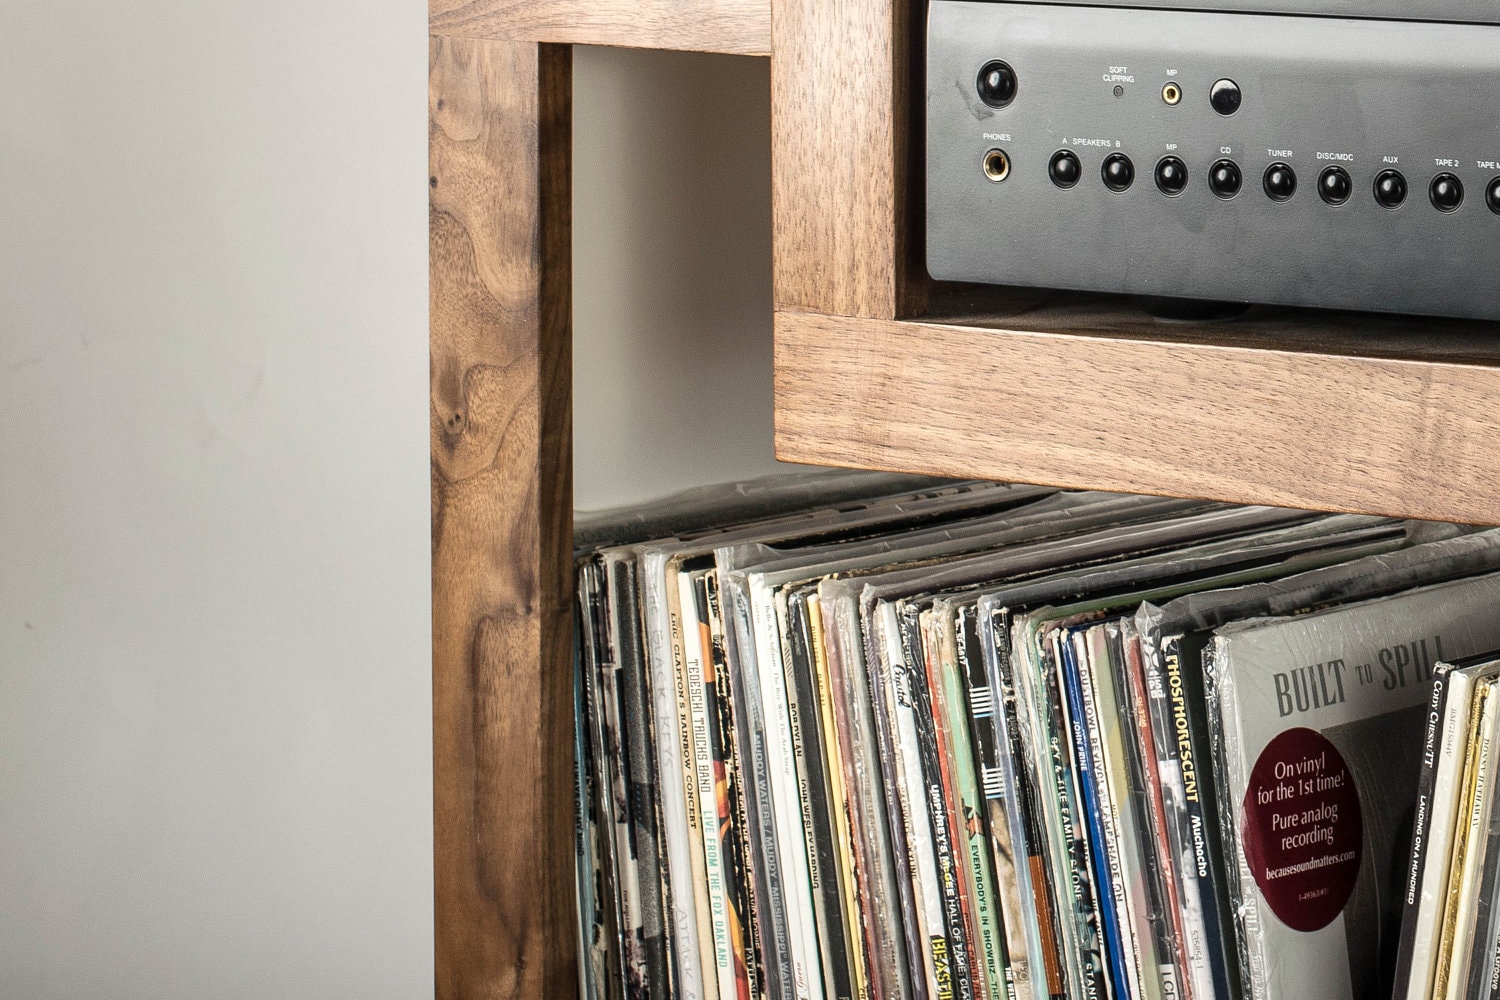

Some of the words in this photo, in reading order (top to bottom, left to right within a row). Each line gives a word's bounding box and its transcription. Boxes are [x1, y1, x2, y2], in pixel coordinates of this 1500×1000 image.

[1103, 74, 1135, 84] CLIPPING
[1109, 66, 1128, 74] SOFT
[1166, 69, 1178, 77] MP
[983, 132, 1011, 142] PHONES
[1062, 137, 1068, 145] A
[1072, 138, 1111, 148] SPEAKERS
[1115, 140, 1121, 149] B
[1165, 143, 1178, 151] MP
[1220, 146, 1232, 155] CD
[1267, 149, 1293, 158] TUNER
[1316, 152, 1354, 162] DISC/MDC
[1383, 156, 1399, 164] AUX
[1435, 158, 1452, 167] TAPE
[1453, 159, 1459, 167] 2
[1477, 161, 1494, 170] TAPE
[649, 629, 667, 700] BLACK
[658, 716, 675, 768] KEYS
[687, 658, 701, 713] TEDESCHI
[893, 664, 912, 709] Capitol
[1273, 658, 1347, 718] BUILT
[1355, 664, 1373, 686] TO
[1430, 680, 1444, 710] CODY
[693, 717, 707, 762] TRUCKS
[1073, 721, 1083, 742] JOHN
[754, 733, 768, 775] MUDDY
[1077, 744, 1089, 772] PRINE
[1166, 654, 1199, 803] PHOSPHORESCENT
[1190, 815, 1208, 878] Muchacho
[1274, 762, 1294, 779] On
[1297, 752, 1326, 776] vinyl
[679, 713, 691, 771] RAINBOW
[686, 775, 697, 830] CONCERT
[699, 765, 712, 793] BAND
[1081, 670, 1098, 732] DUSTBOWL
[1112, 882, 1123, 902] ON
[1257, 786, 1274, 806] for
[1276, 783, 1295, 800] the
[1298, 779, 1314, 796] 1st
[1316, 769, 1345, 793] time!
[759, 779, 771, 822] WATERS
[1415, 794, 1427, 835] LANDING
[703, 811, 715, 833] LIVE
[930, 784, 949, 854] UMPHREY'S
[1061, 807, 1076, 853] FAMILY
[1272, 811, 1300, 831] Pure
[1301, 802, 1339, 825] analog
[1281, 824, 1335, 851] recording
[1415, 837, 1422, 849] ON
[707, 840, 719, 869] FROM
[765, 835, 777, 877] MUDDY
[1265, 850, 1356, 880] becausesoundmatters.com
[709, 873, 721, 891] THE
[971, 845, 987, 914] EVERYBODY'S
[981, 917, 990, 926] IN
[1407, 861, 1419, 905] HUNDRED
[711, 895, 723, 915] FOX
[946, 899, 959, 923] HALL
[713, 920, 729, 968] OAKLAND
[951, 926, 962, 940] OF
[1191, 930, 1204, 969] 535854-1
